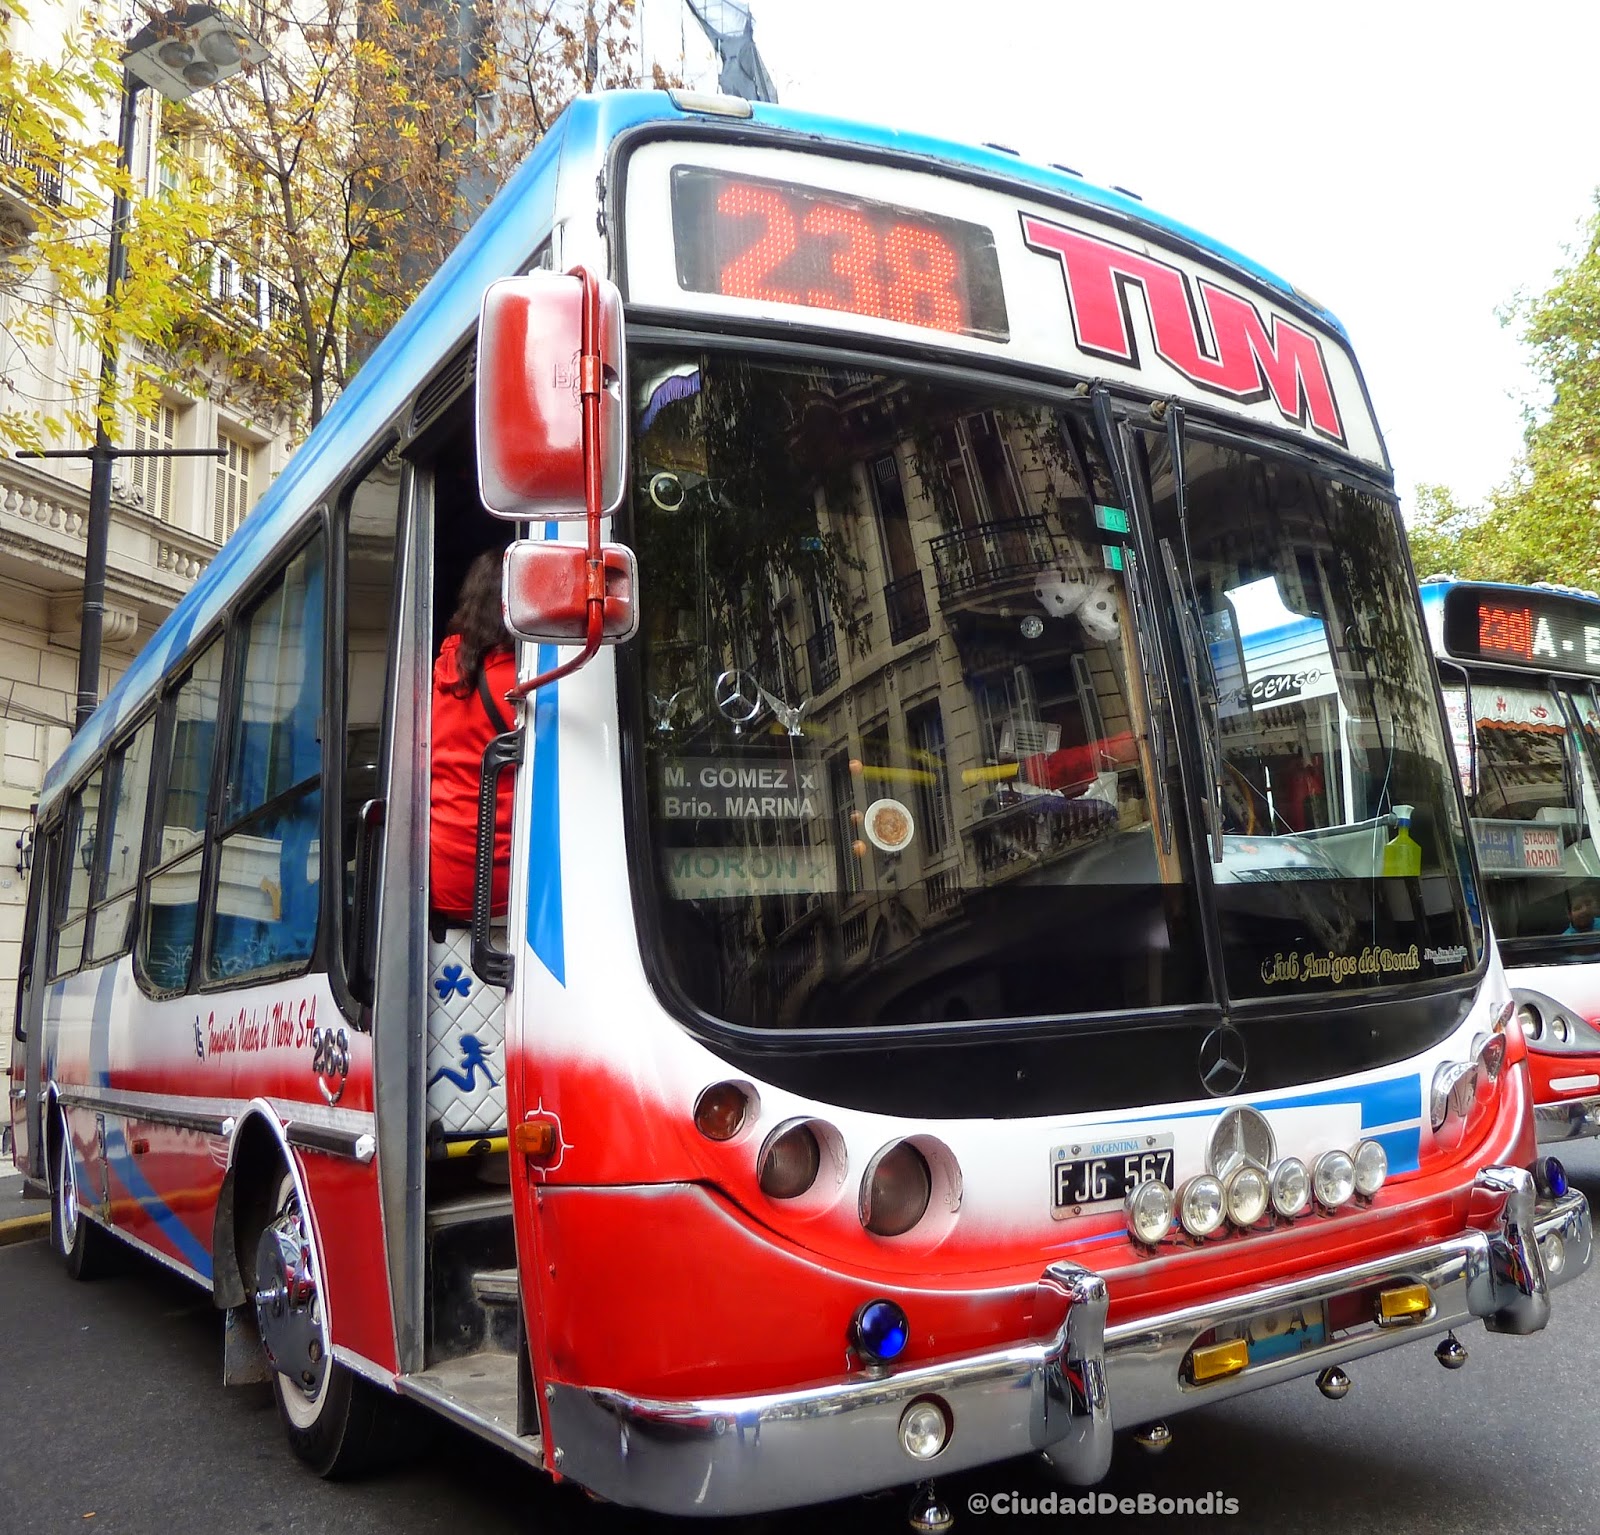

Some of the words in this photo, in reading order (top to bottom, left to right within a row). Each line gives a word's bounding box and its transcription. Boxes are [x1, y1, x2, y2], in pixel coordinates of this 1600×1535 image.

[717, 183, 962, 333] 238
[1018, 209, 1347, 449] TUM
[664, 767, 691, 788] M.
[700, 768, 788, 789] GOMEZ
[664, 797, 717, 818] Brio.
[725, 797, 815, 817] MARINA
[1261, 952, 1299, 984] Club
[1300, 950, 1357, 983] Amigos
[1359, 946, 1381, 974] del
[1380, 944, 1420, 971] Bondi
[1090, 1140, 1139, 1155] ARGENTINA
[1058, 1160, 1107, 1205] FJG
[1124, 1151, 1171, 1192] 567
